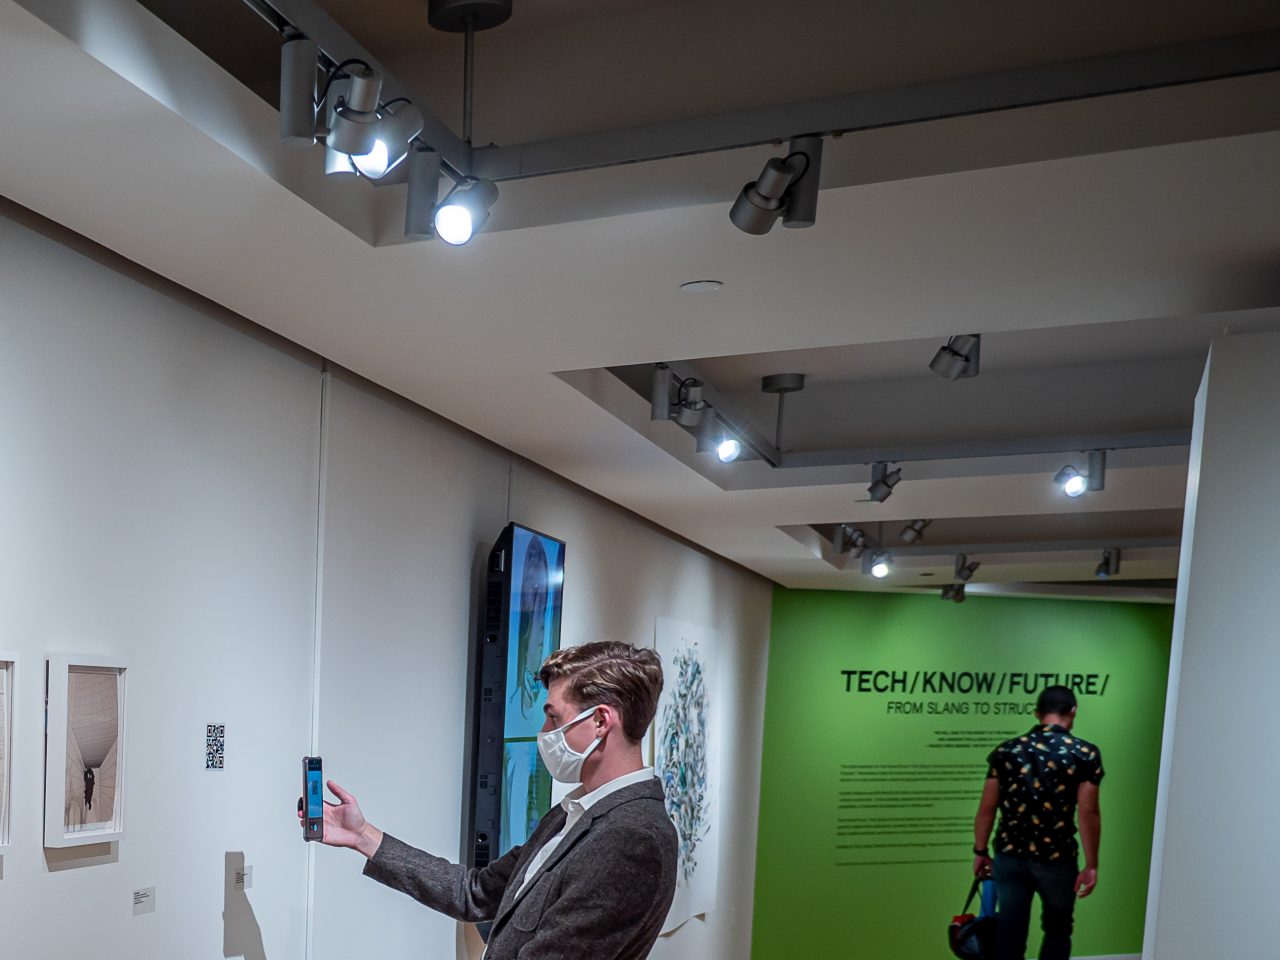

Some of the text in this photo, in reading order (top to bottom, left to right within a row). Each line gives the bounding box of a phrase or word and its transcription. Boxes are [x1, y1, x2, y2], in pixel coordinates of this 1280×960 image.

[886, 701, 1036, 715] FROM SLANG TO STRUC
